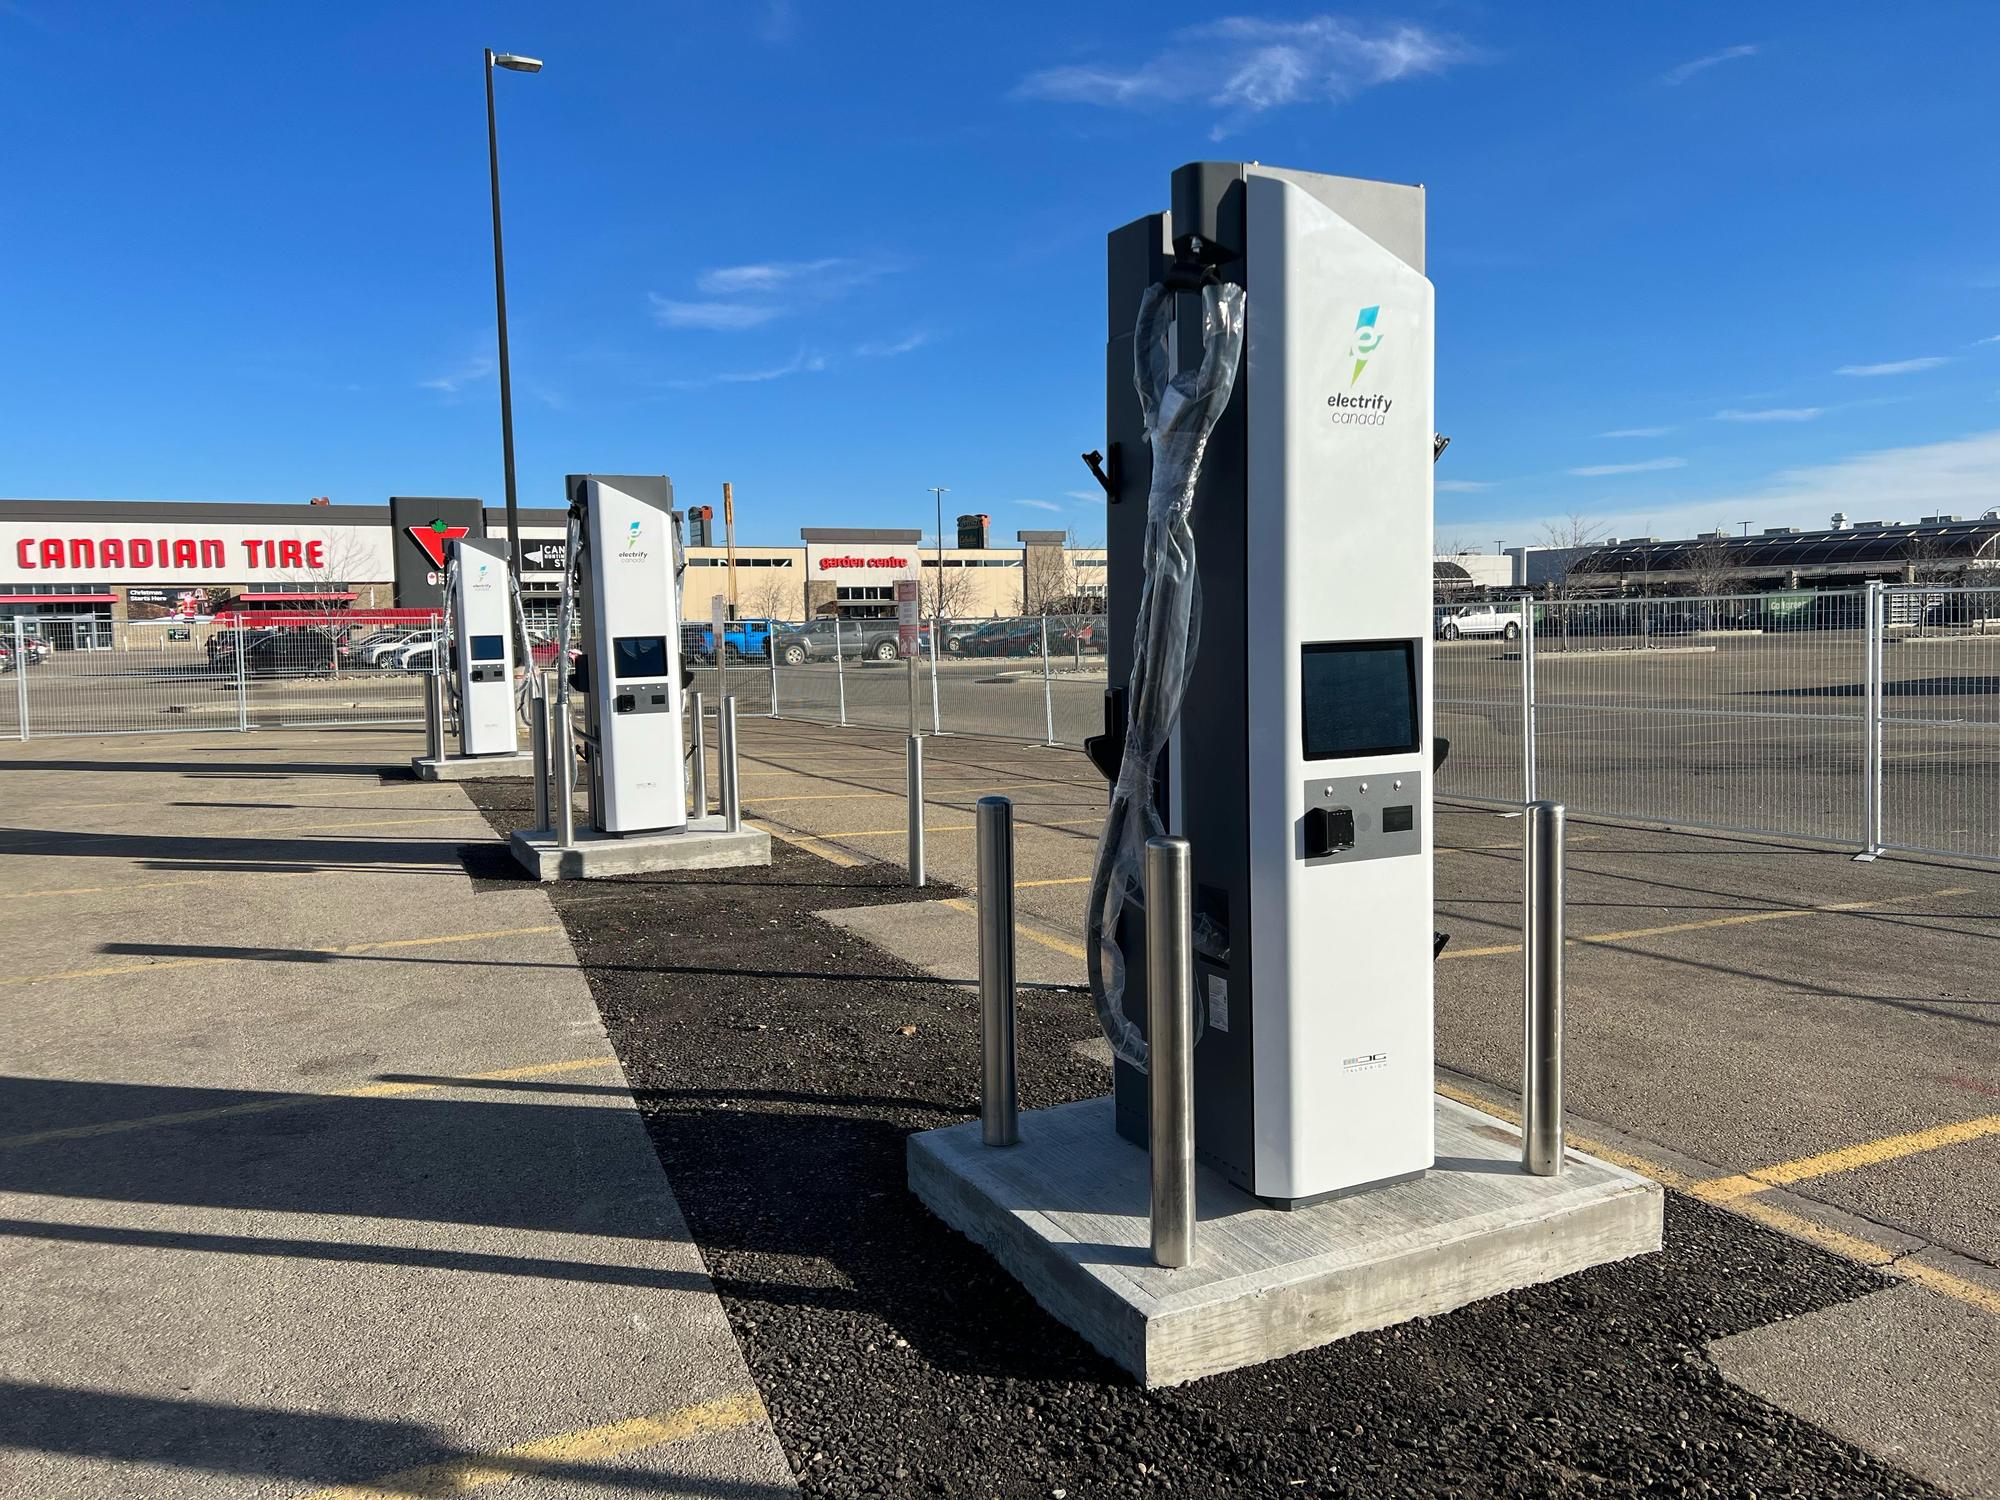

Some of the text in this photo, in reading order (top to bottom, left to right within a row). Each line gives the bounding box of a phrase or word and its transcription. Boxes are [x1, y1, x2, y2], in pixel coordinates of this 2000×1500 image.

[1327, 392, 1392, 413] electrify
[1331, 411, 1386, 426] canada
[16, 538, 324, 569] CANADIAN TIRE
[618, 551, 648, 559] electrify
[819, 556, 908, 570] garden centre
